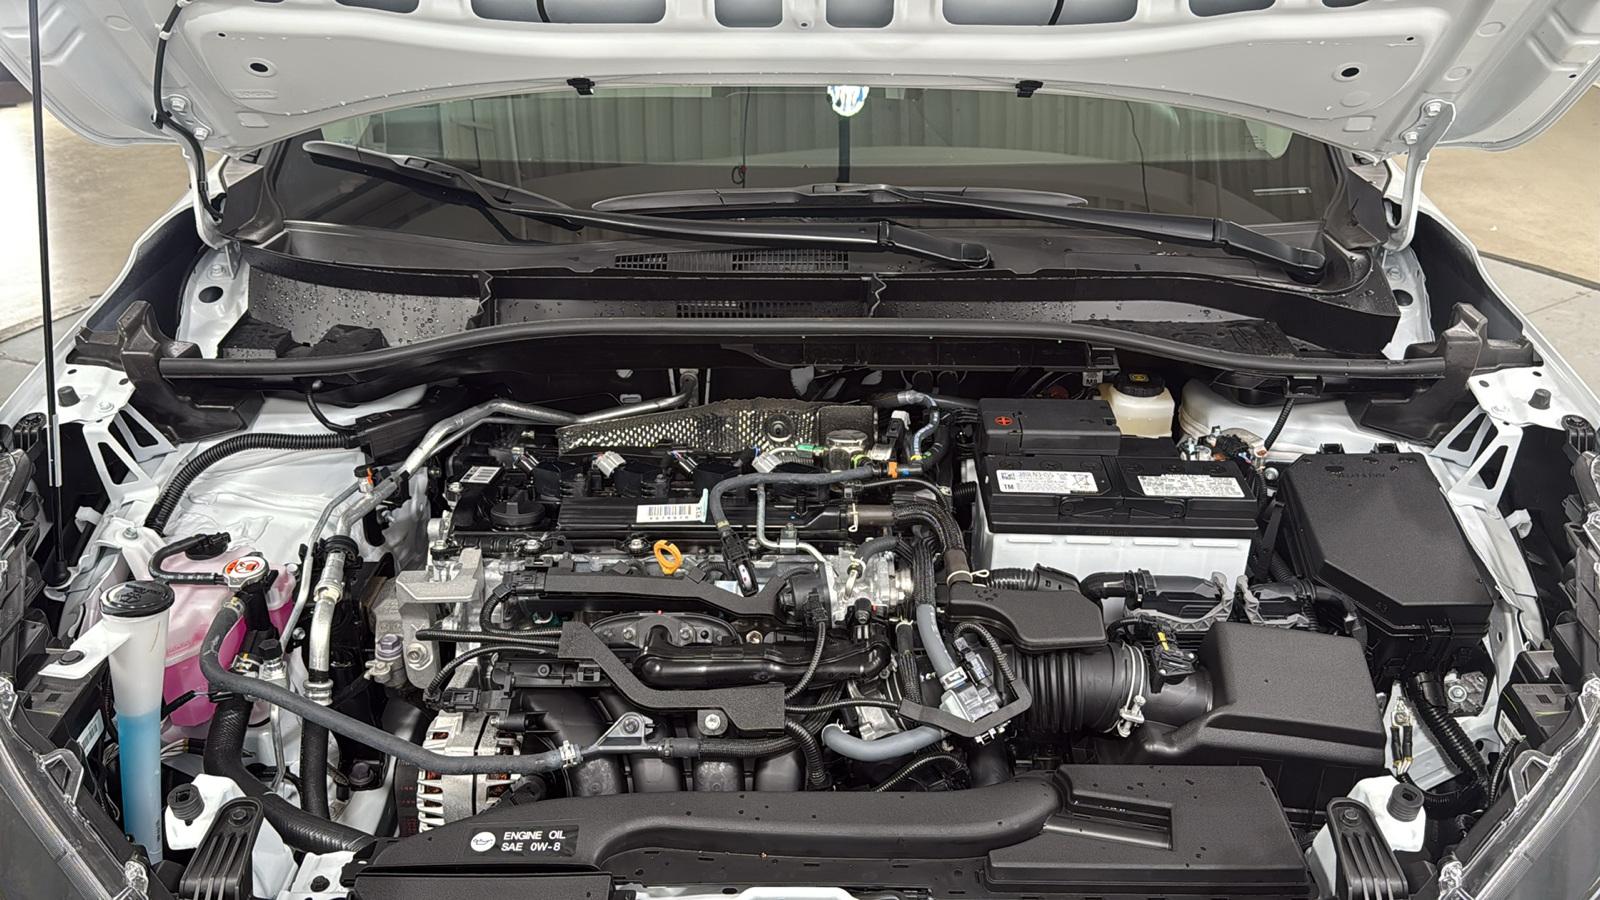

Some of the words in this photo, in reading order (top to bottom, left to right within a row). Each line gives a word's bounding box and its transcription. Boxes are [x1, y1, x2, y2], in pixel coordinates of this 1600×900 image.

[503, 831, 543, 840] ENGINE
[548, 830, 566, 840] OIL
[501, 842, 523, 852] SAE
[530, 842, 561, 852] 0W-8
